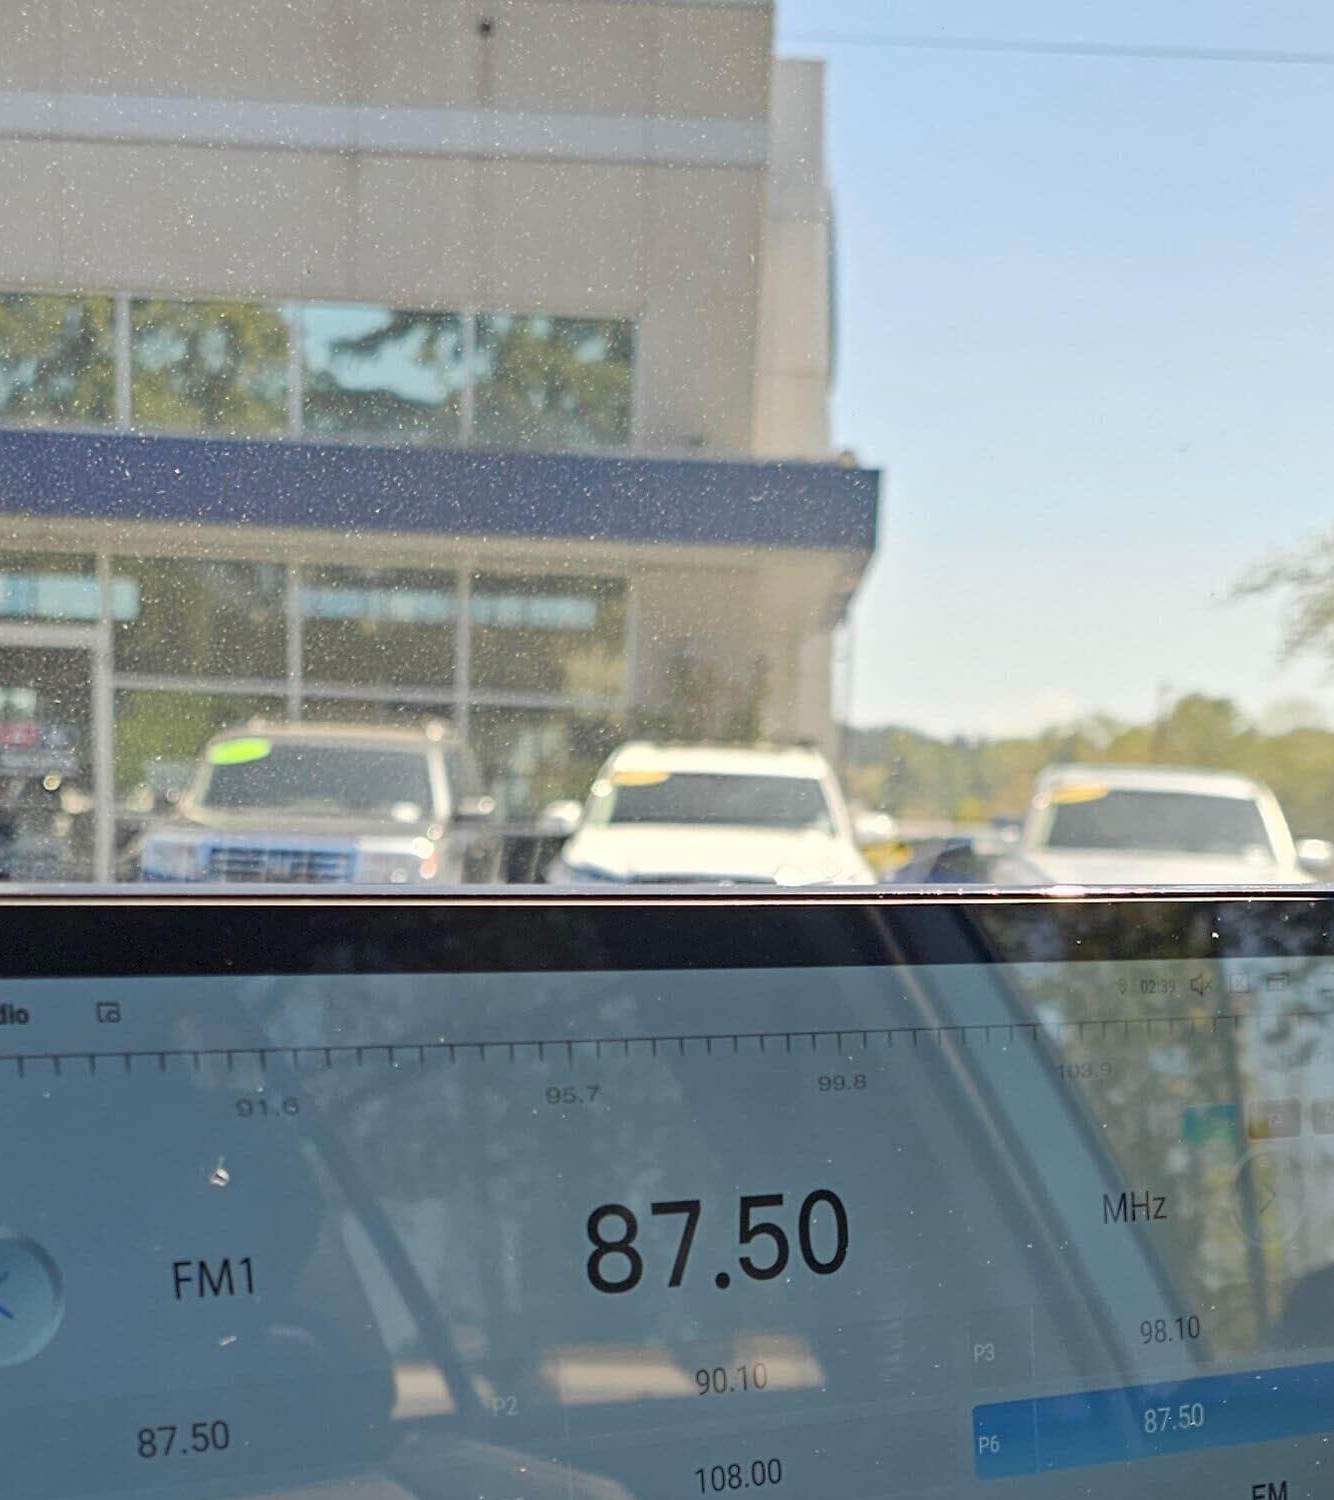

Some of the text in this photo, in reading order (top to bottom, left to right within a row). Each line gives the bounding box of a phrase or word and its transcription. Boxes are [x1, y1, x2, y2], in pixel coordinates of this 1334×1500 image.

[1139, 978, 1176, 994] 02:39
[545, 1085, 601, 1105] 95.7
[817, 1074, 867, 1092] 99.8
[235, 1097, 299, 1118] 91.6
[1102, 1193, 1168, 1225] MHz
[586, 1189, 850, 1294] 87.50
[173, 1258, 255, 1300] FM1
[973, 1315, 1201, 1363] P3 98.10
[694, 1361, 769, 1397] 90.10
[137, 1420, 231, 1459] 87.50
[978, 1402, 1205, 1455] P6 87.50
[695, 1459, 783, 1494] 108.00
